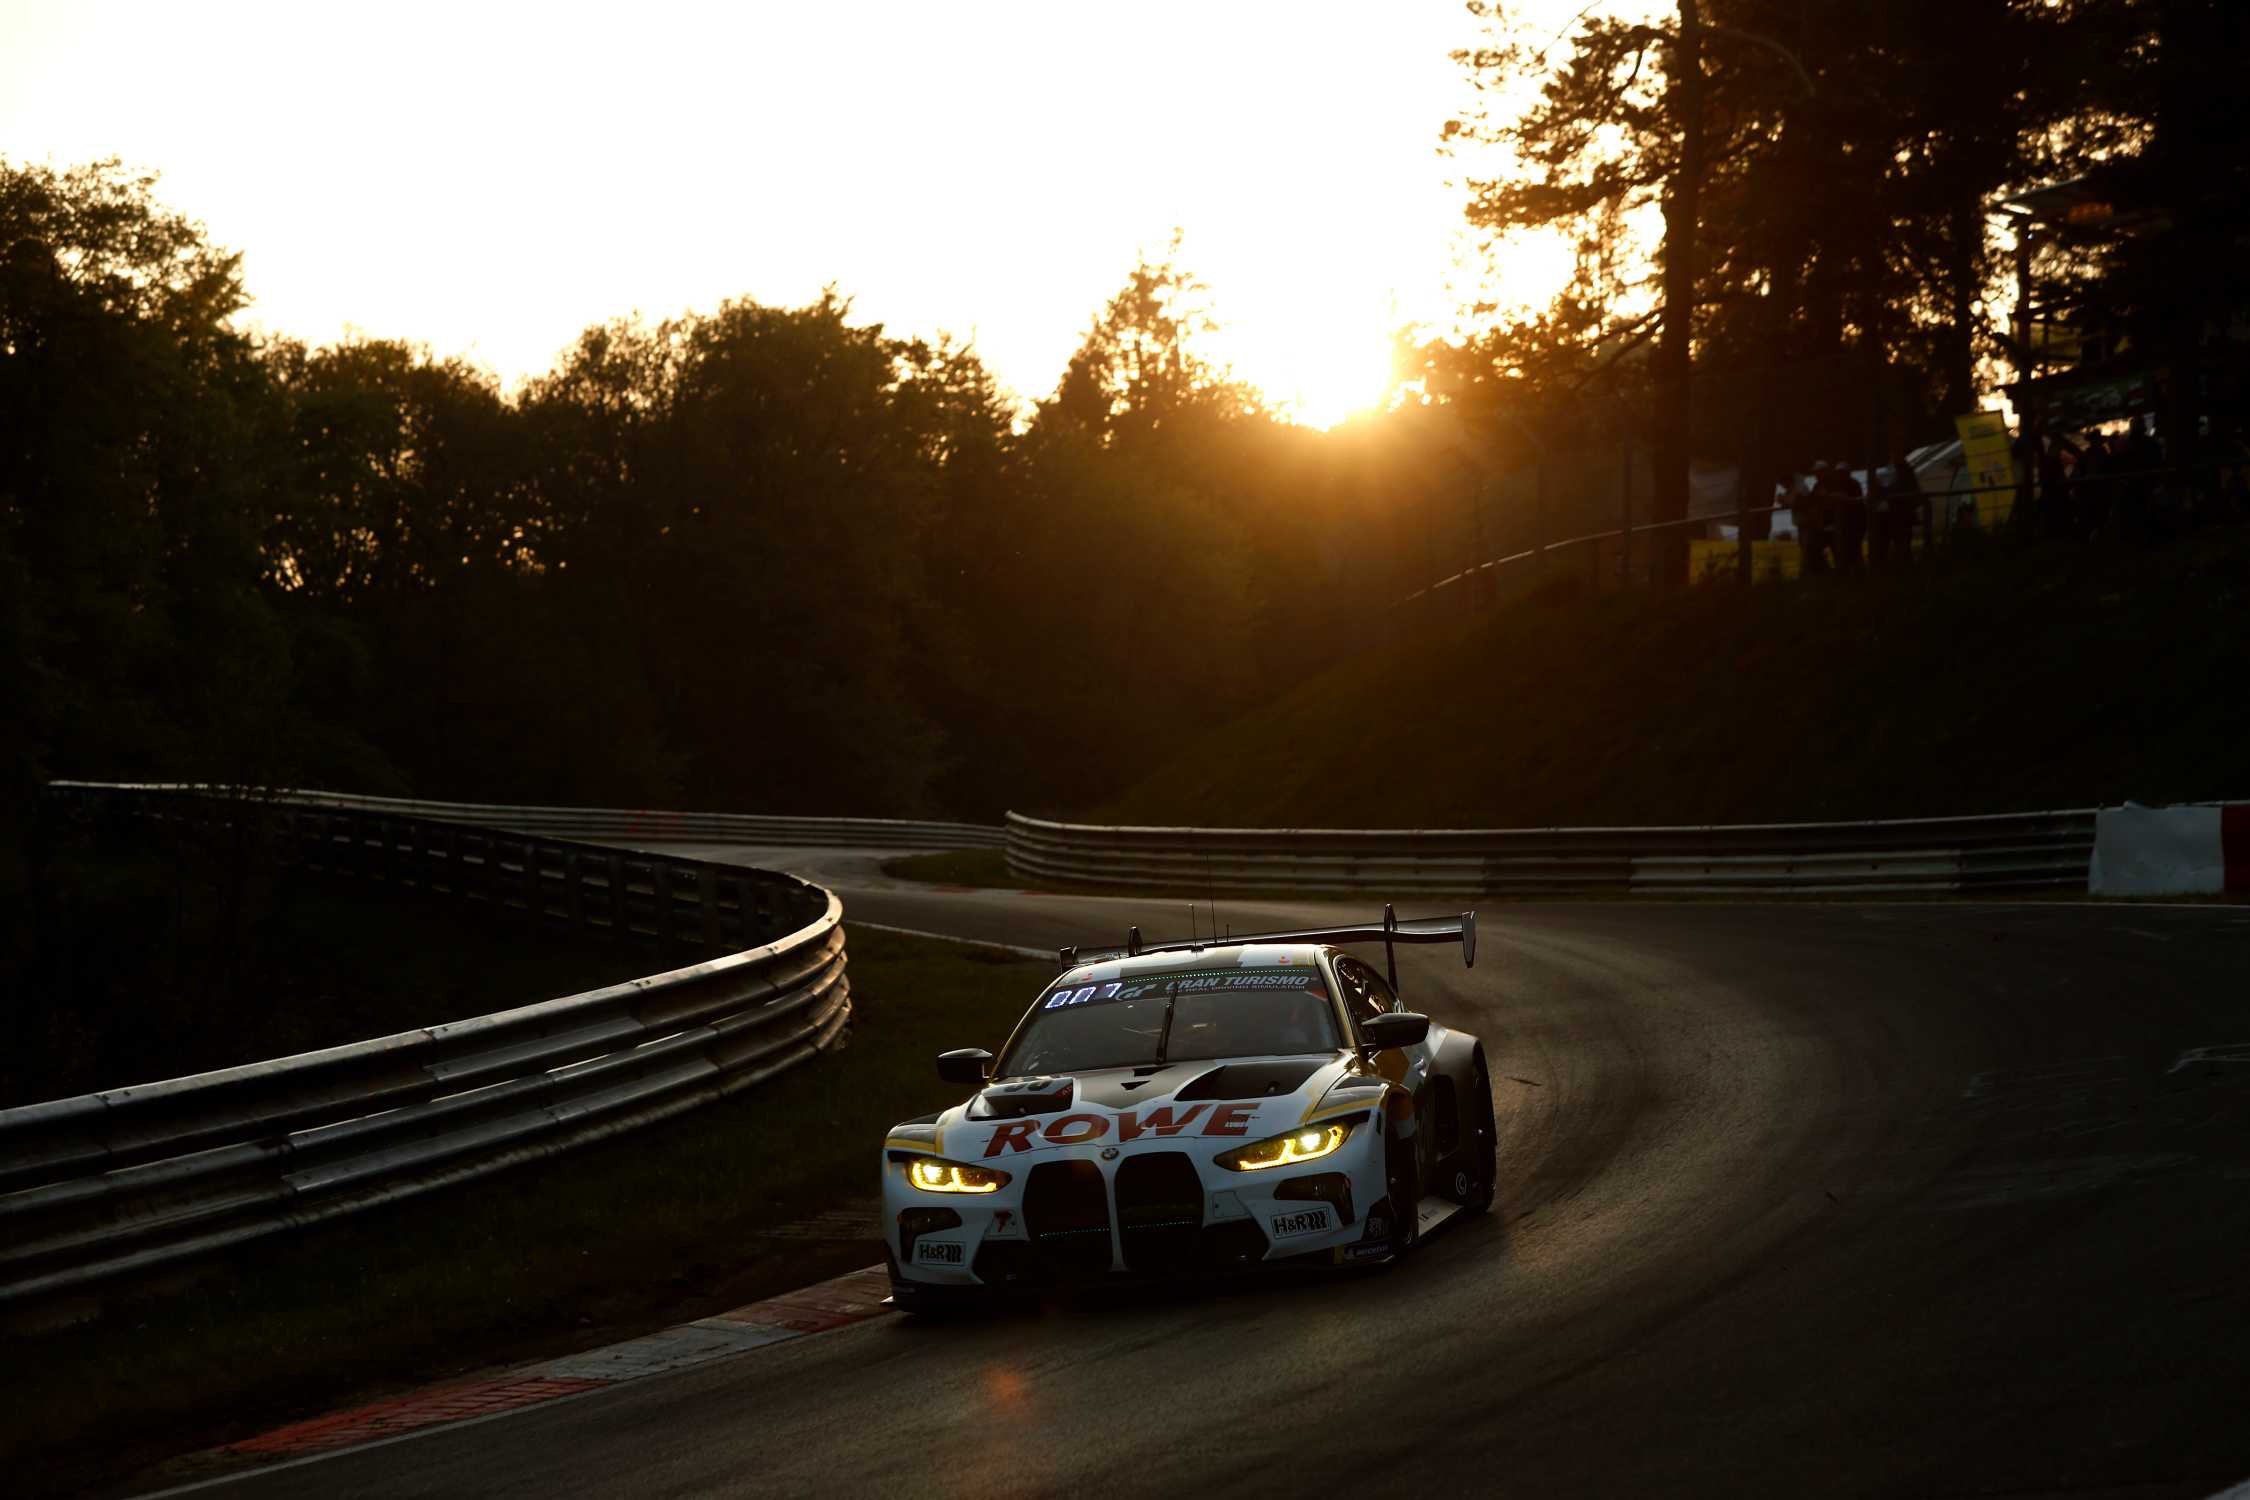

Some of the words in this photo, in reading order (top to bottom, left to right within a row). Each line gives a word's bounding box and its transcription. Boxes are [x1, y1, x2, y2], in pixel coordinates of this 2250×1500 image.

[1223, 976, 1309, 987] TURISMO
[984, 1103, 1260, 1158] ROWE
[1273, 1214, 1307, 1234] H&R
[919, 1243, 945, 1259] H&R
